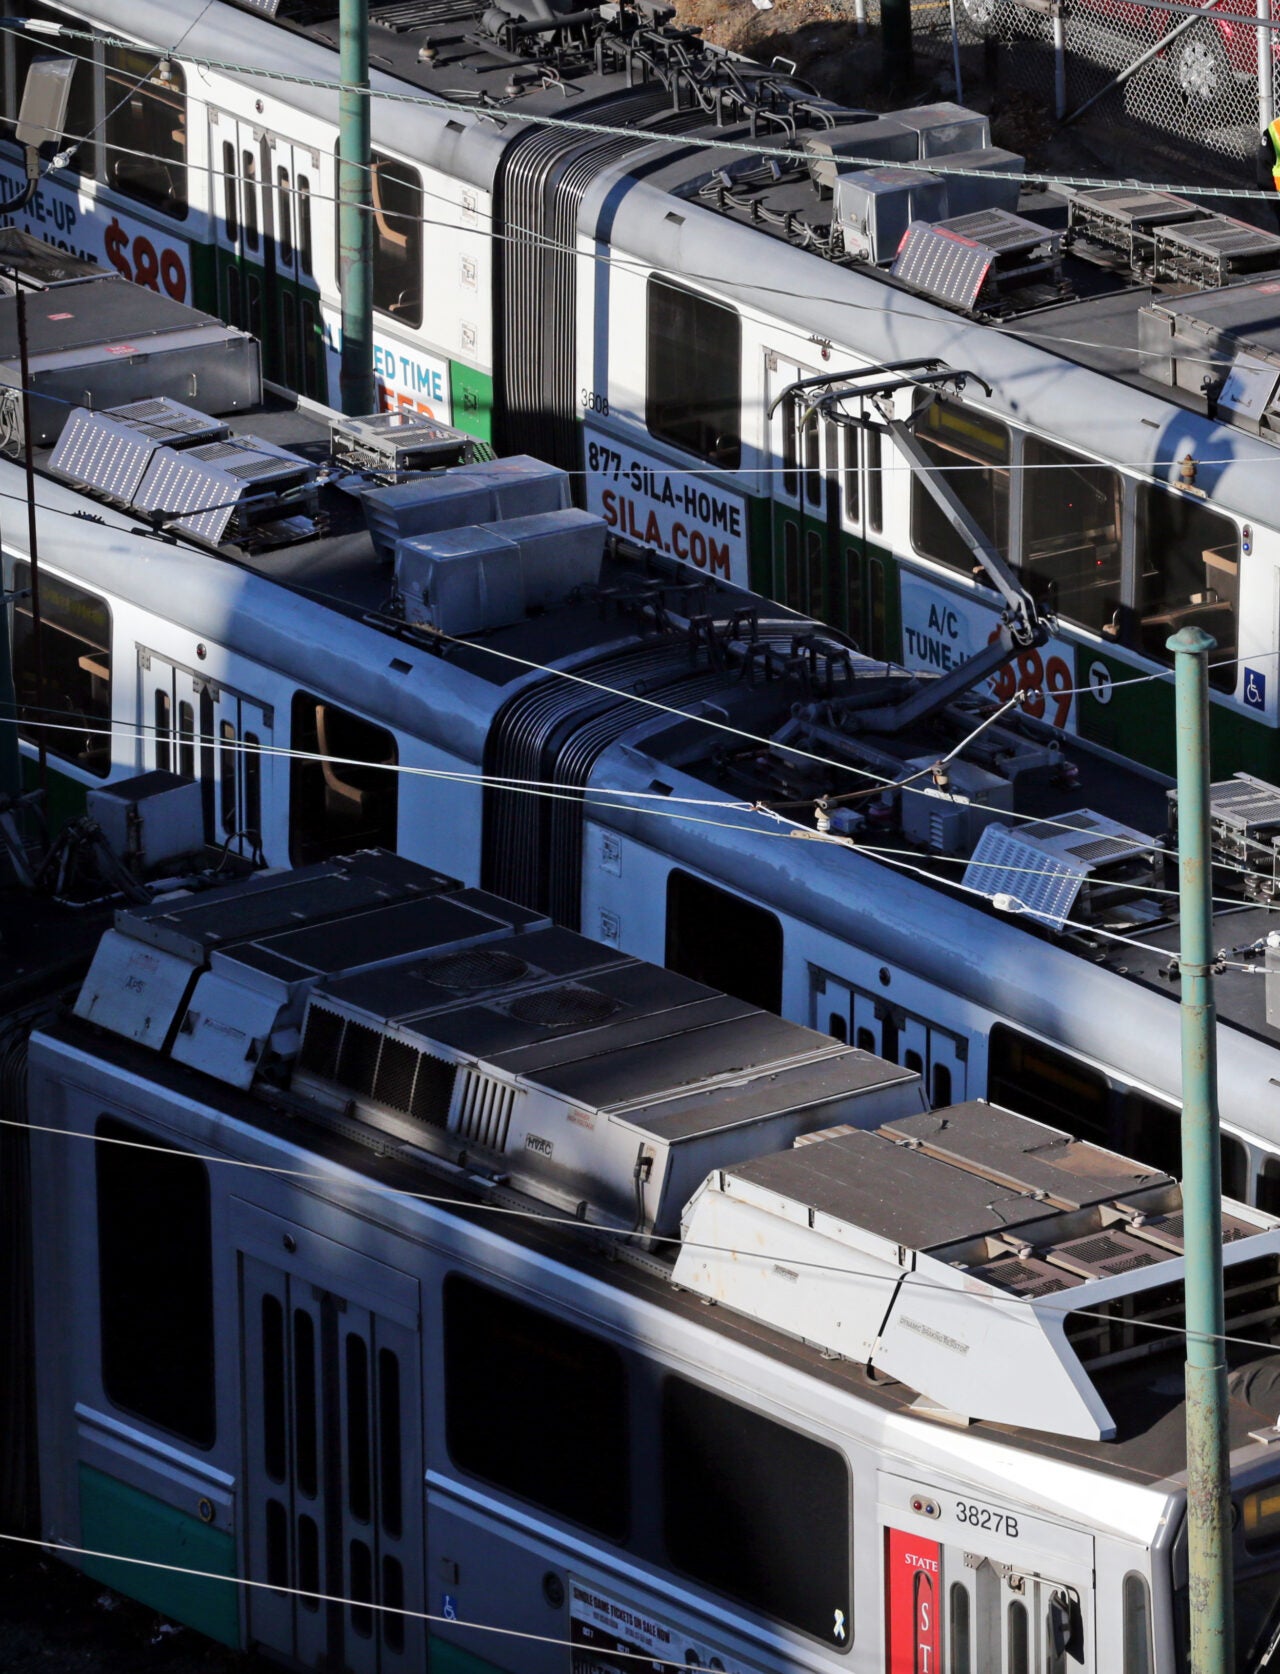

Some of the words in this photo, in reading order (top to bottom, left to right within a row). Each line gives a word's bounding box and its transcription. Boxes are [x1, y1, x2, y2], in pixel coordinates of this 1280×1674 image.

[400, 357, 443, 402] TIME
[581, 388, 610, 417] 3608
[588, 441, 742, 538] 877-SILA-HOME
[601, 489, 731, 581] SILA.COM
[928, 603, 958, 639] A/C
[527, 1136, 551, 1156] HVAC
[955, 1502, 1019, 1538] 3827B
[904, 1553, 939, 1573] STATE
